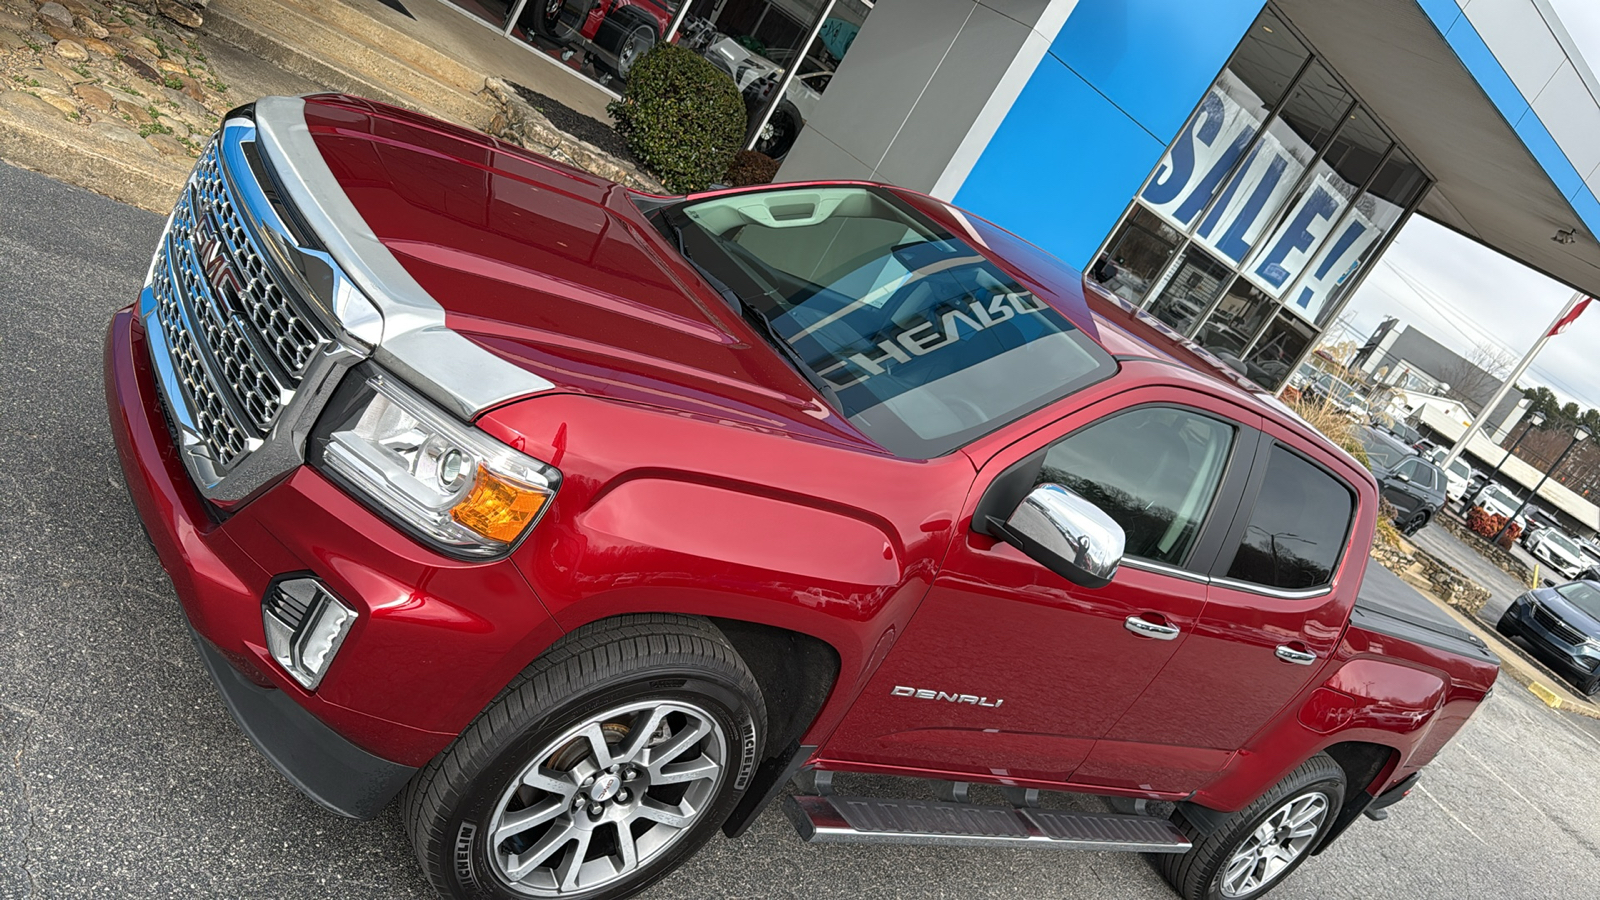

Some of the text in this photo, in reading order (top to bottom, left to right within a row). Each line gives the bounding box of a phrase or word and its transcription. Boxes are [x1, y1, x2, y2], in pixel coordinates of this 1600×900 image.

[1141, 90, 1367, 309] SALE!
[195, 212, 242, 317] GMC
[890, 685, 1004, 708] DENALI
[738, 723, 755, 787] MICHELIN
[597, 778, 614, 800] GMC
[457, 826, 477, 892] MICHELIN
